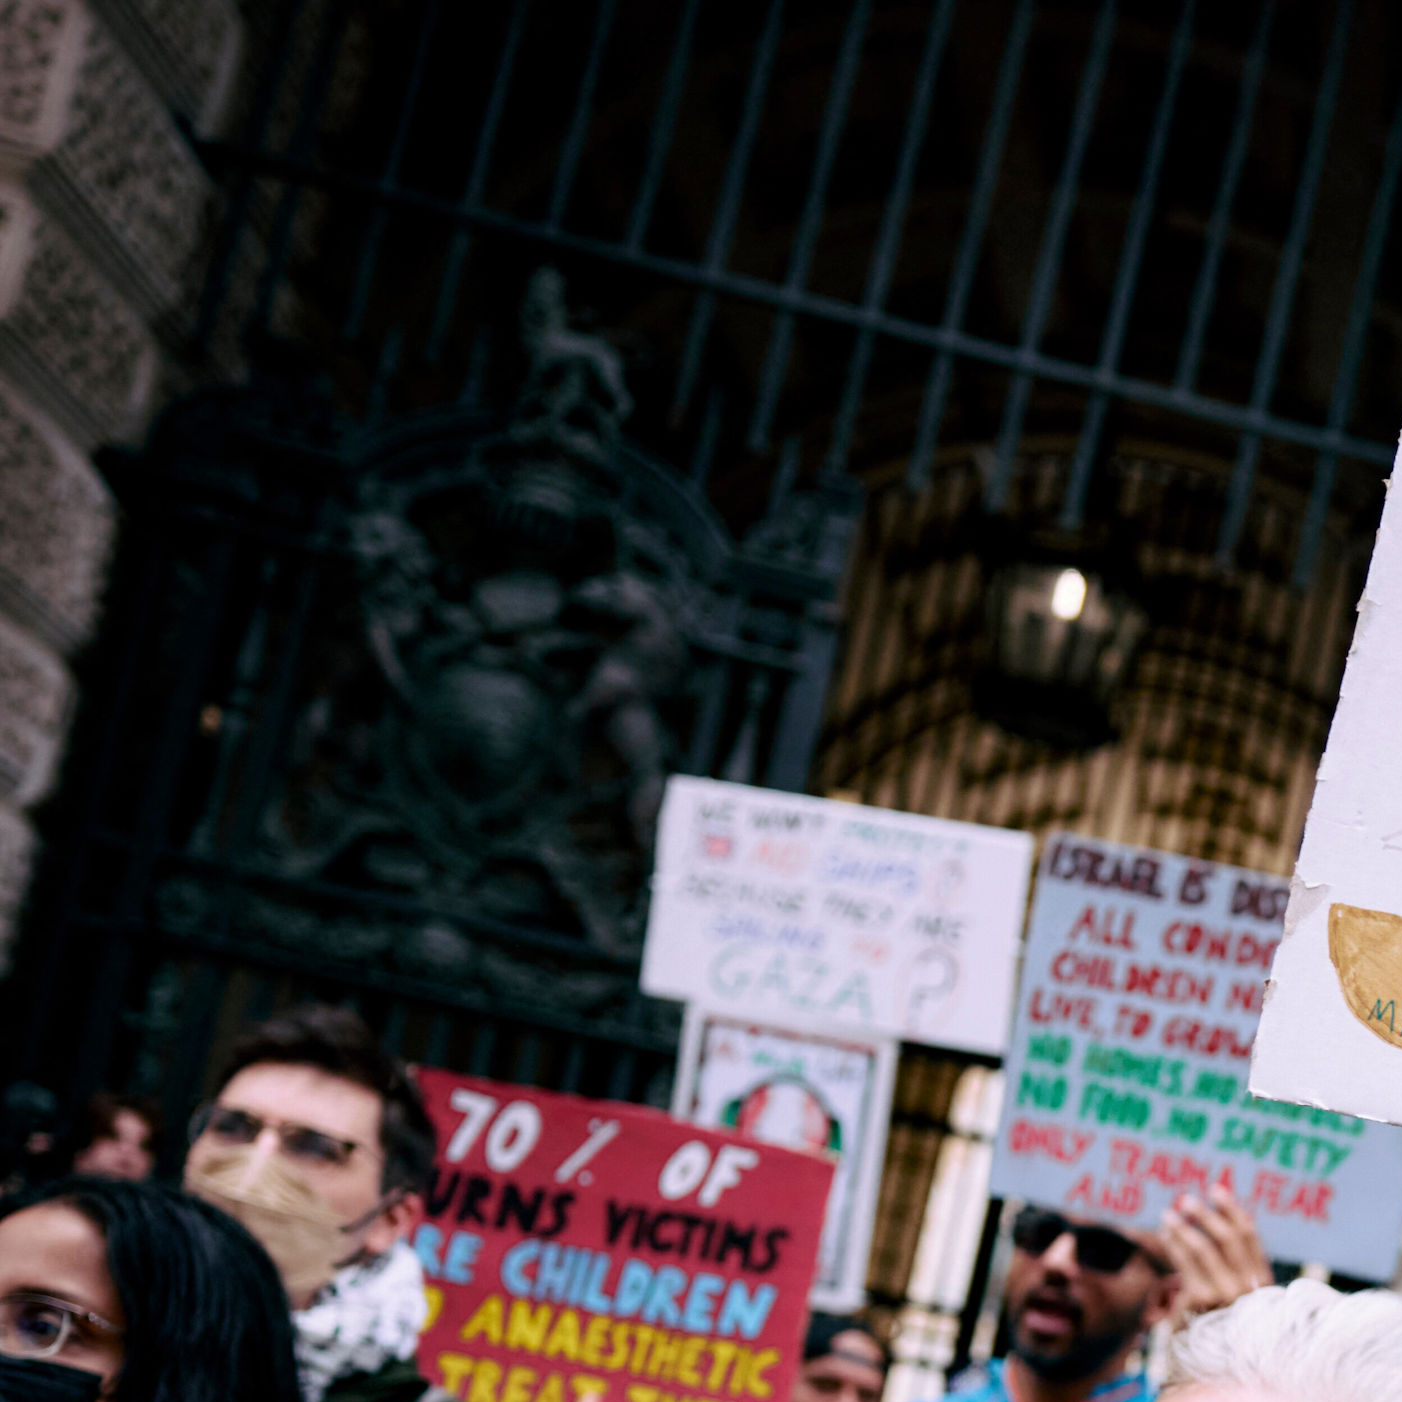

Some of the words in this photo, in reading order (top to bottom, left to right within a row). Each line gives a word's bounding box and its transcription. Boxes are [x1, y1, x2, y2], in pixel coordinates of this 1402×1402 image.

[1049, 843, 1163, 898] ISRAEL
[1070, 906, 1138, 951] ALL
[708, 944, 876, 1020] GAZA
[1051, 950, 1213, 1004] CHILDREN
[445, 1088, 542, 1174] 70
[658, 1140, 760, 1207] OF
[422, 1168, 577, 1241] URNS
[606, 1199, 791, 1275] VICTIMS
[413, 1222, 484, 1286] RE
[501, 1237, 778, 1340] CHILDREN
[460, 1294, 781, 1398] ANAESTHETIC
